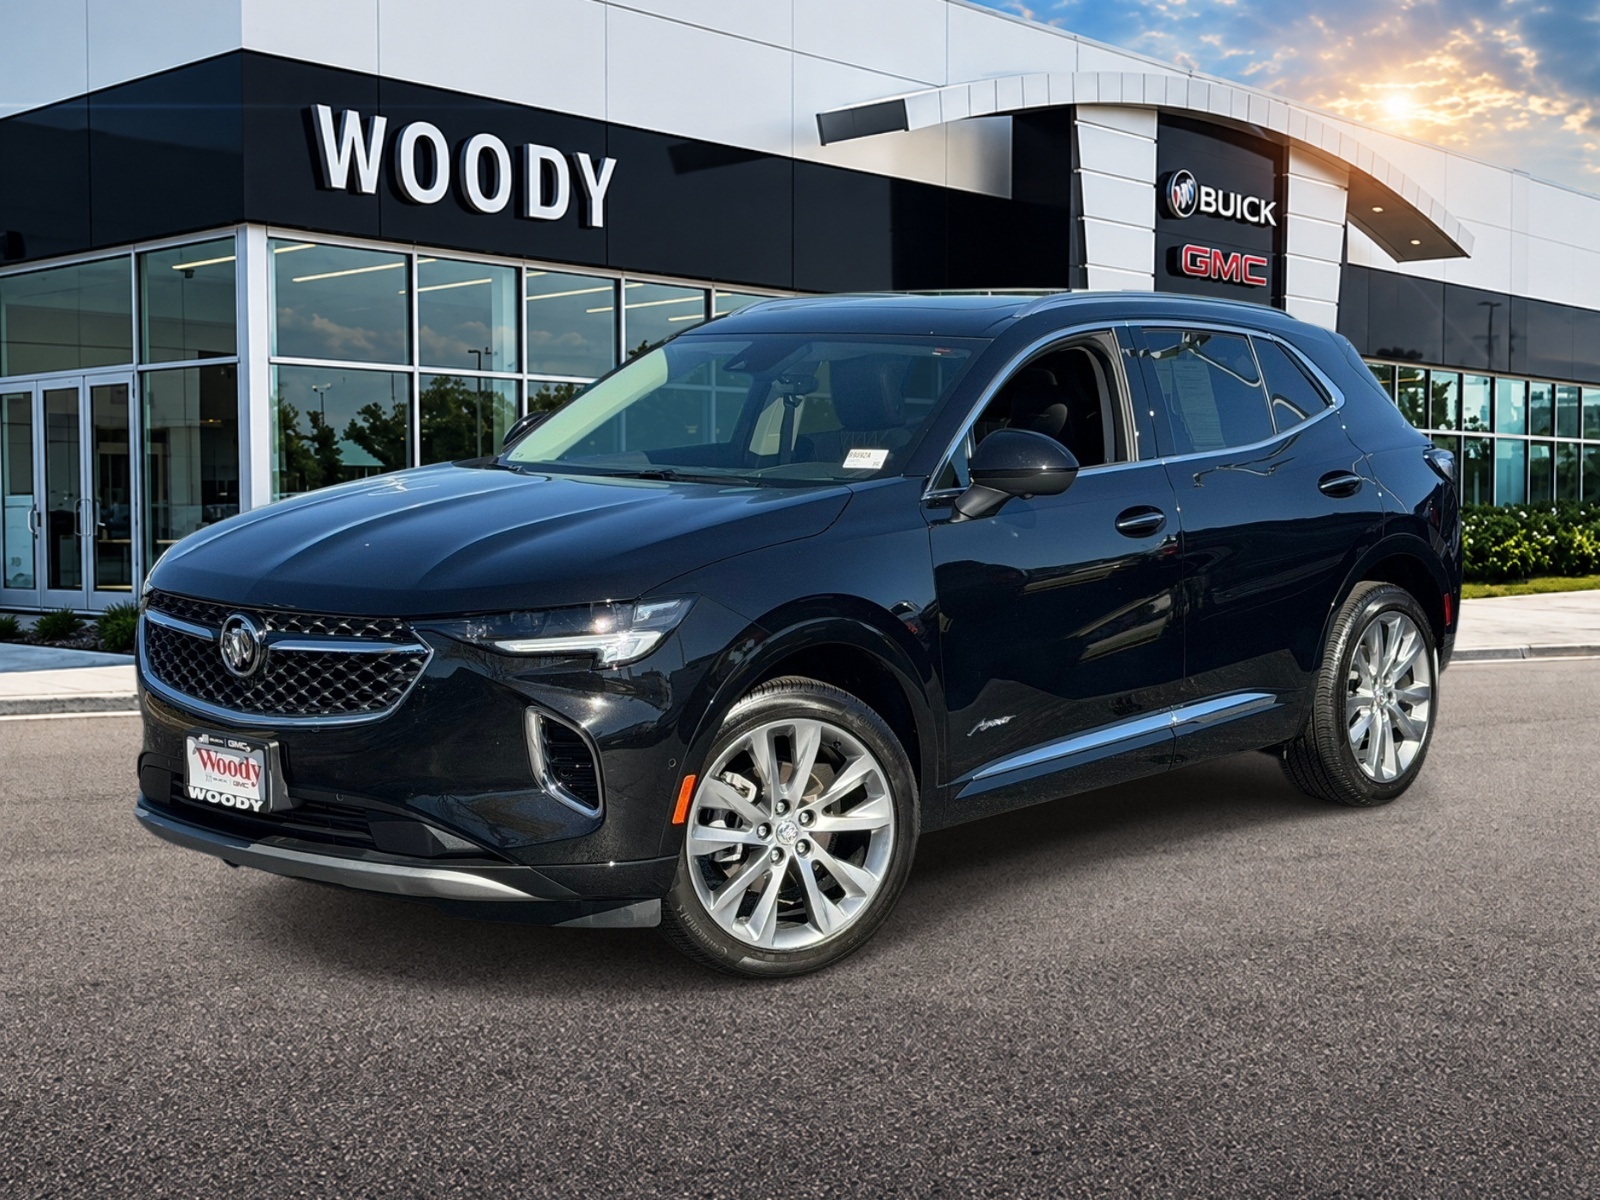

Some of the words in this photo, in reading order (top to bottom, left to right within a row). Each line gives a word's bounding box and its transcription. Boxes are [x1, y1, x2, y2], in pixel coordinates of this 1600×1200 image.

[311, 103, 617, 228] WOODY
[1200, 185, 1277, 226] BUICK
[1182, 244, 1267, 286] GMC
[228, 740, 248, 751] GMC
[195, 747, 262, 788] Woody
[233, 781, 249, 789] GMC
[188, 786, 263, 812] WOODY
